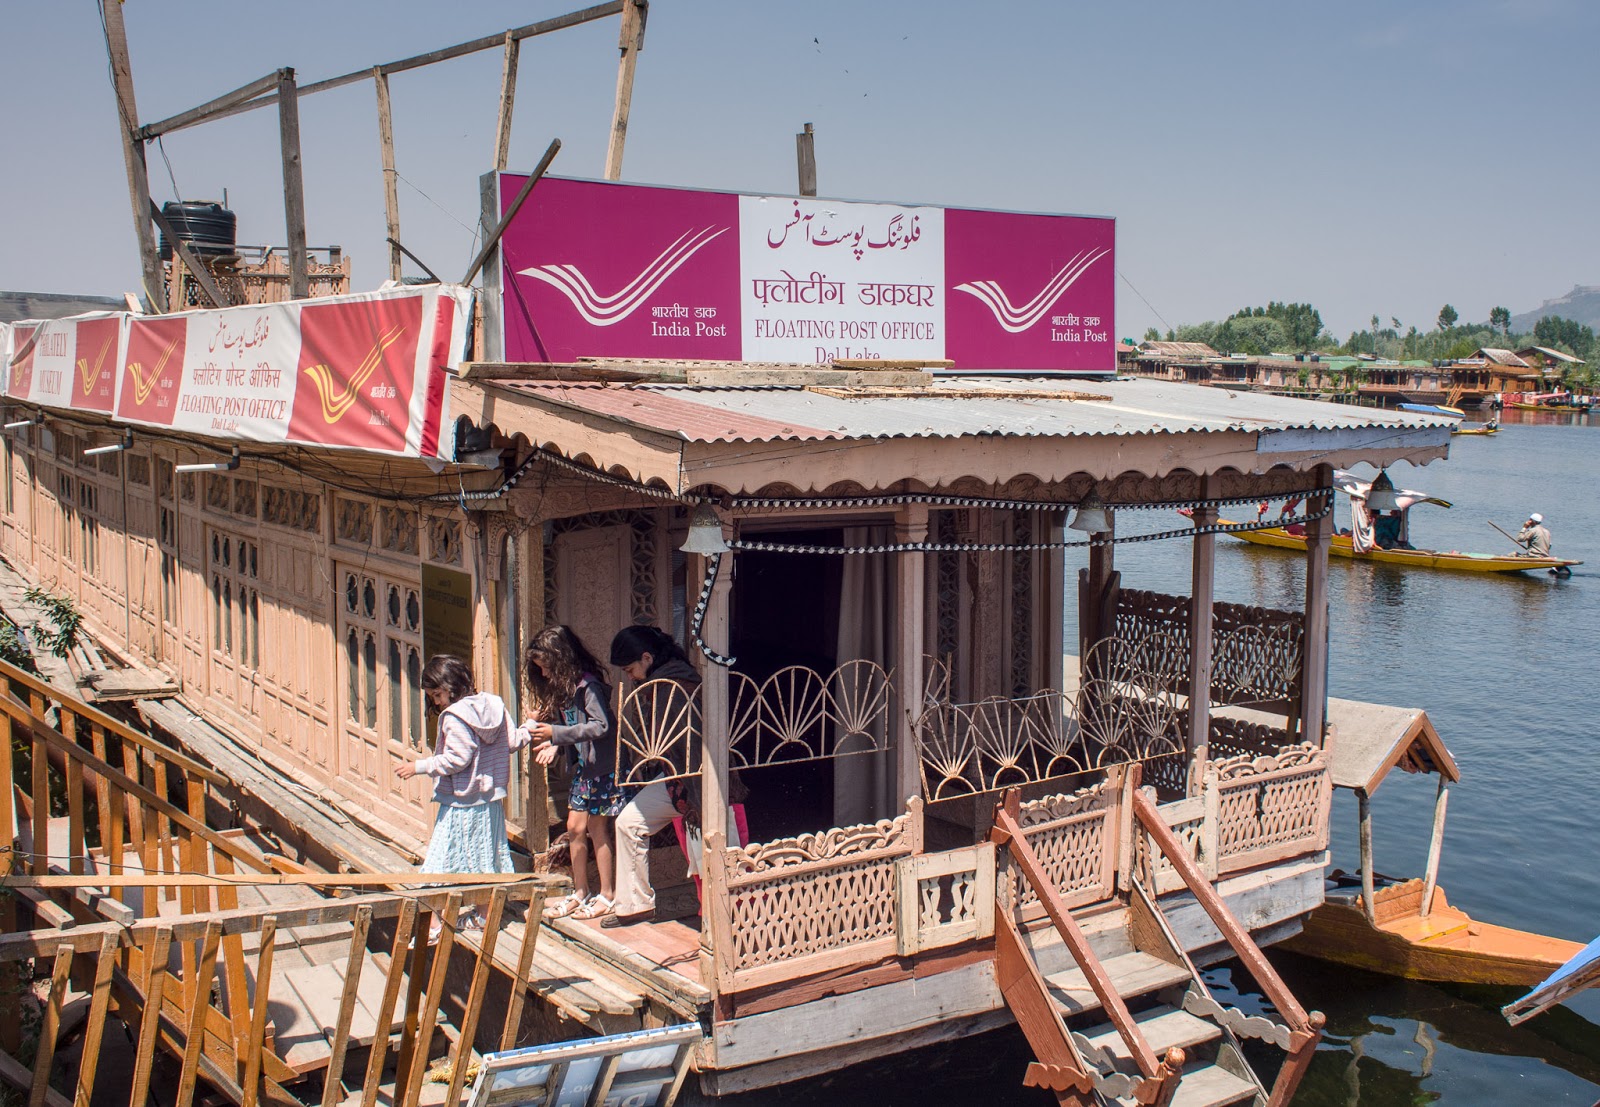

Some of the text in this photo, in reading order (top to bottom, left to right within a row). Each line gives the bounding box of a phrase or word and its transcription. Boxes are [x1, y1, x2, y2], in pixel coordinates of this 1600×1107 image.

[767, 200, 815, 249] آفس
[812, 225, 865, 261] پوسٹ
[857, 282, 935, 307] डाकघर
[651, 303, 717, 318] भारतीय डाक
[1083, 316, 1101, 327] डाक
[651, 322, 727, 337] India Post
[754, 319, 935, 340] FLOATING POST OFFICE
[1051, 328, 1108, 342] India Post
[225, 361, 246, 387] पोस्ट
[180, 394, 223, 415] FLOATING
[223, 397, 248, 419] POST
[248, 398, 287, 420] OFFICE
